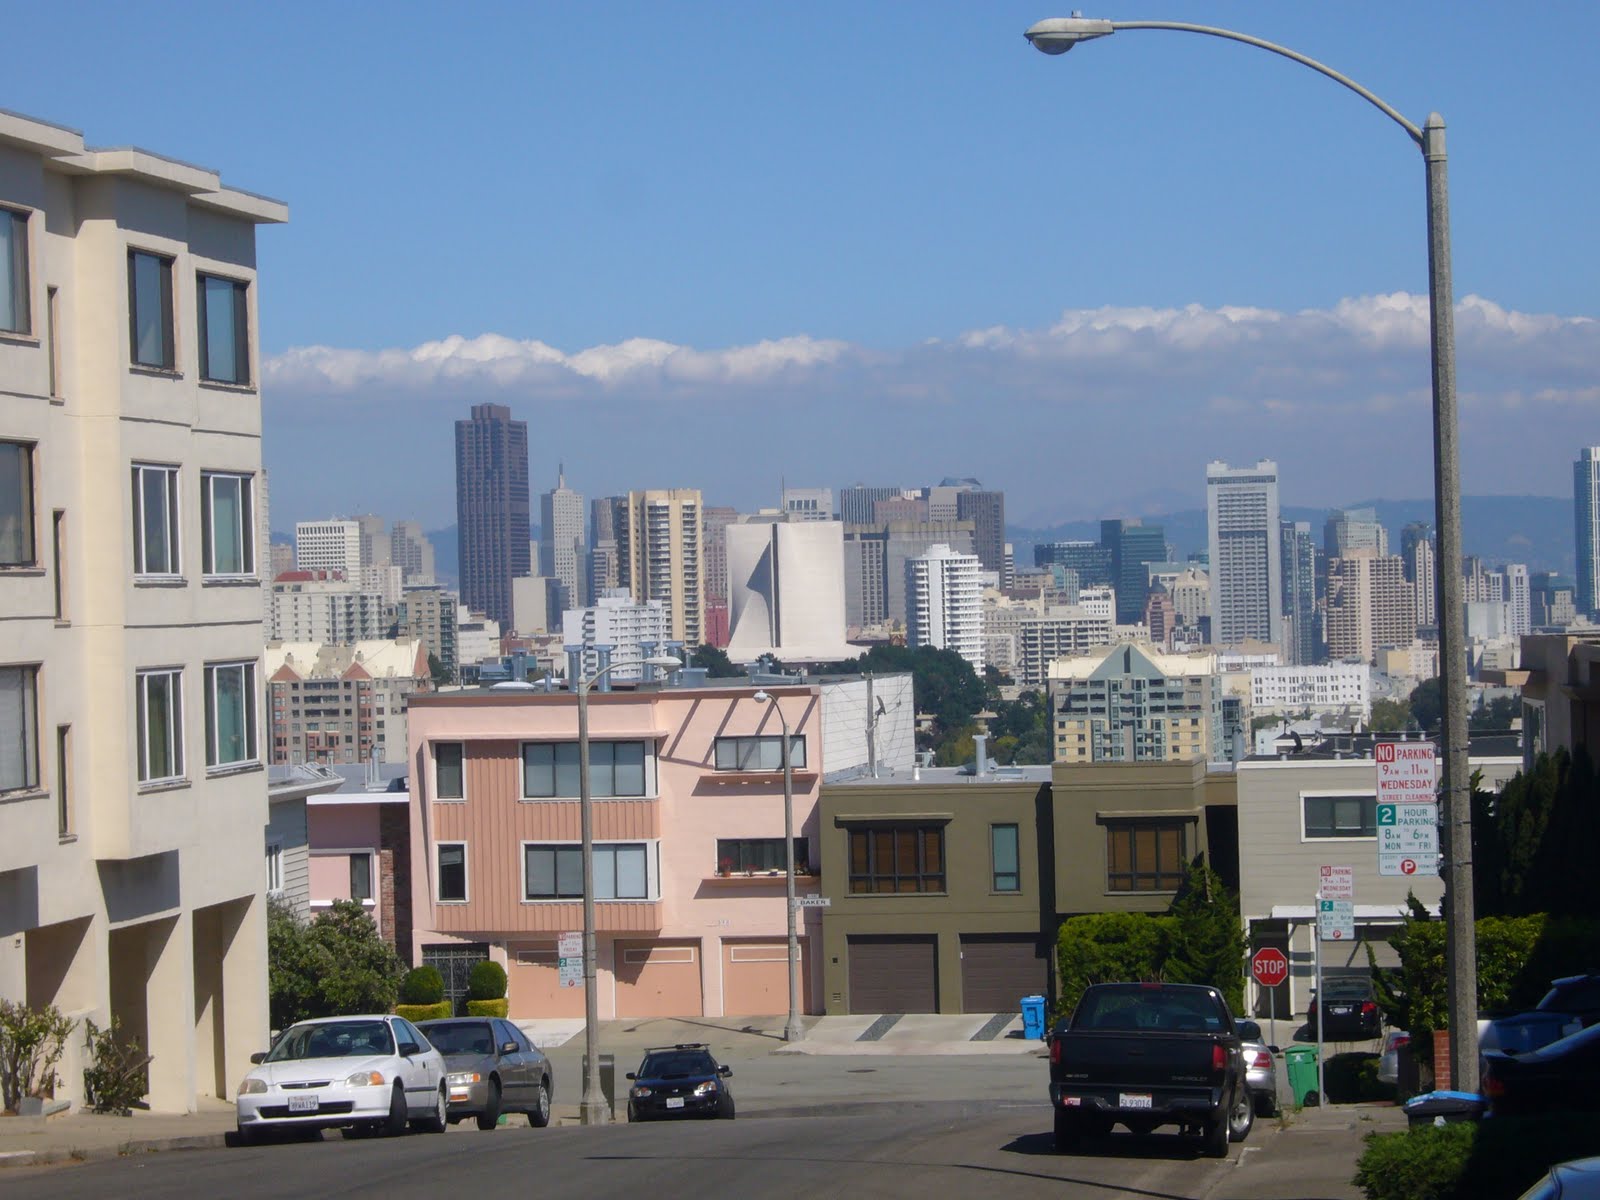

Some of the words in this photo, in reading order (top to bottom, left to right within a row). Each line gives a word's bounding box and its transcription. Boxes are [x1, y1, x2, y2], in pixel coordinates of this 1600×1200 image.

[1377, 745, 1393, 761] NO
[1396, 748, 1434, 760] PARKING
[1380, 779, 1433, 790] WEDNESDAY
[1405, 793, 1433, 801] CLEANING
[1381, 807, 1393, 823] 2
[1404, 808, 1428, 817] HOUR
[1397, 817, 1435, 826] PARKING
[1384, 842, 1402, 850] MON
[1418, 841, 1432, 850] FRI
[1324, 901, 1330, 911] 2
[1255, 960, 1285, 974] STOP
